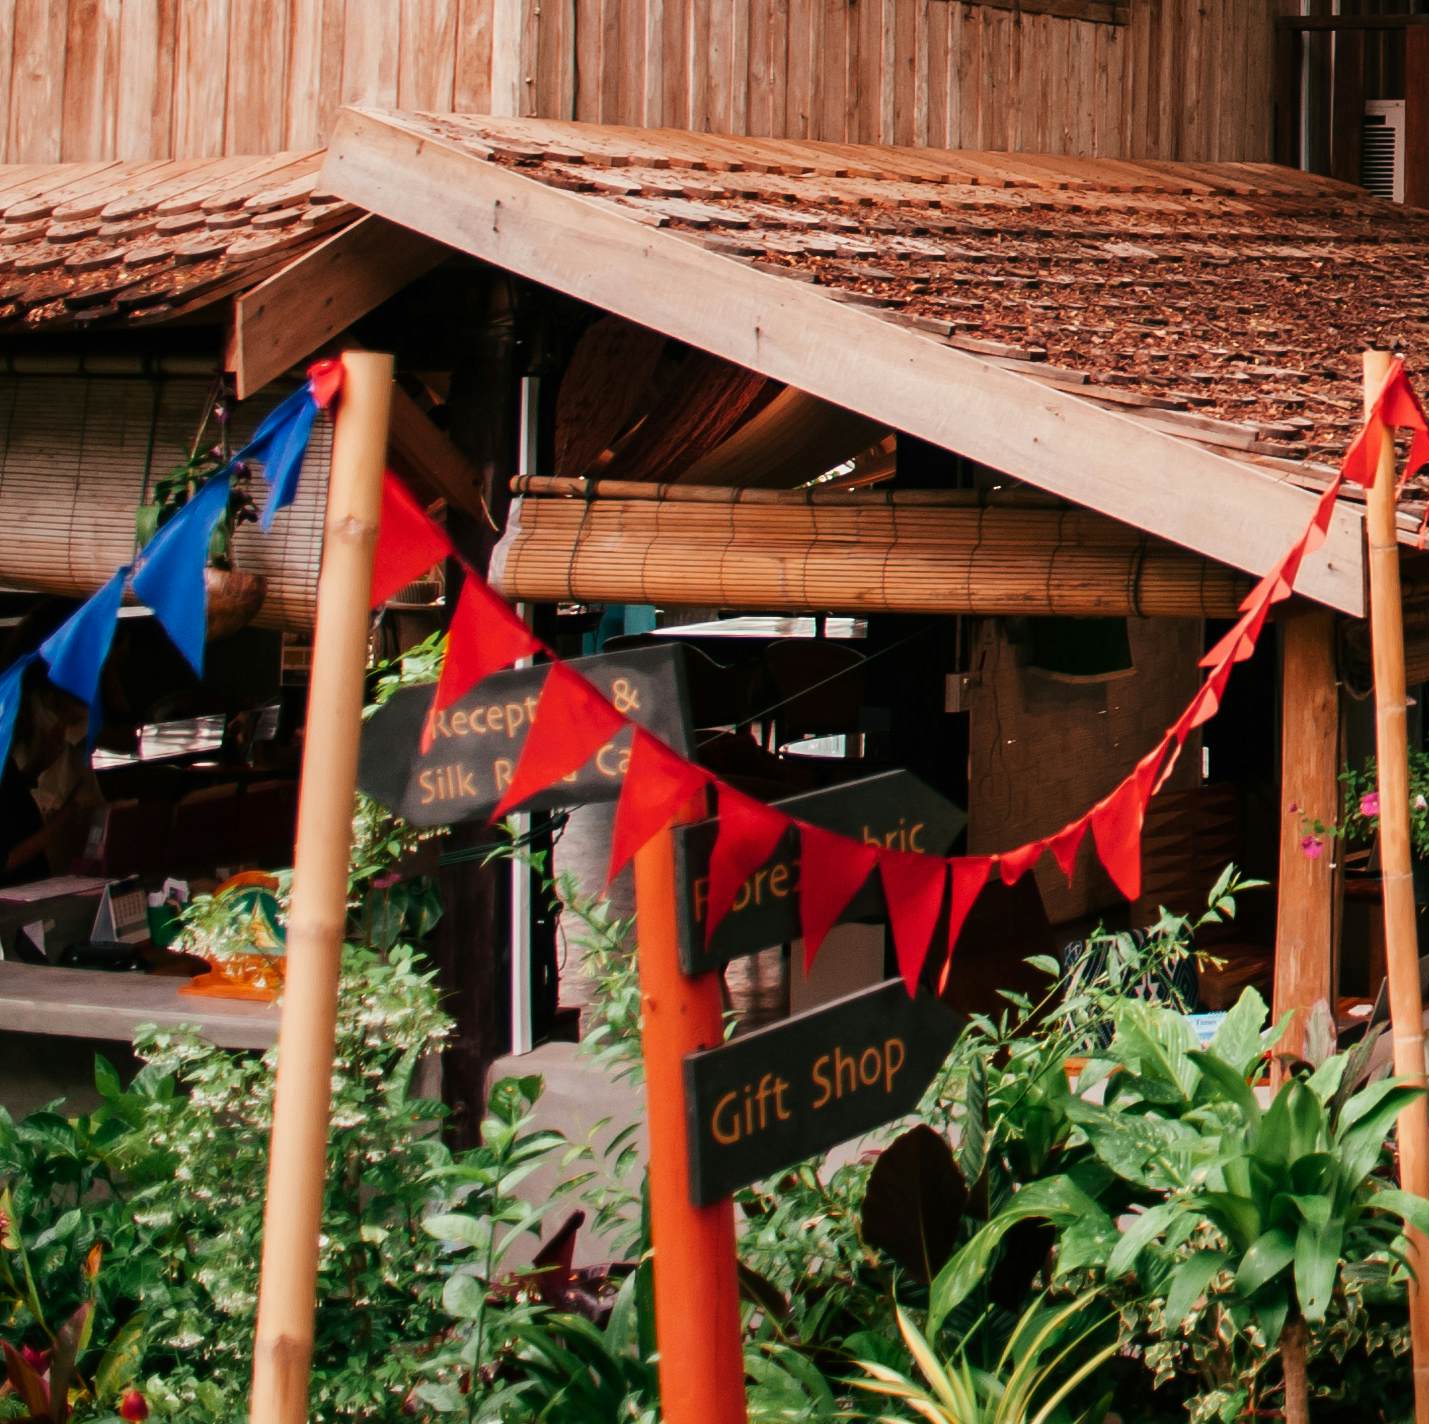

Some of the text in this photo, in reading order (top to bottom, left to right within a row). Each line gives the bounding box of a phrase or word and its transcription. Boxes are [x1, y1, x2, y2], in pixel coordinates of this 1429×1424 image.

[612, 678, 641, 713] &
[418, 759, 478, 805] Silk
[711, 1037, 906, 1146] Gift Shop
